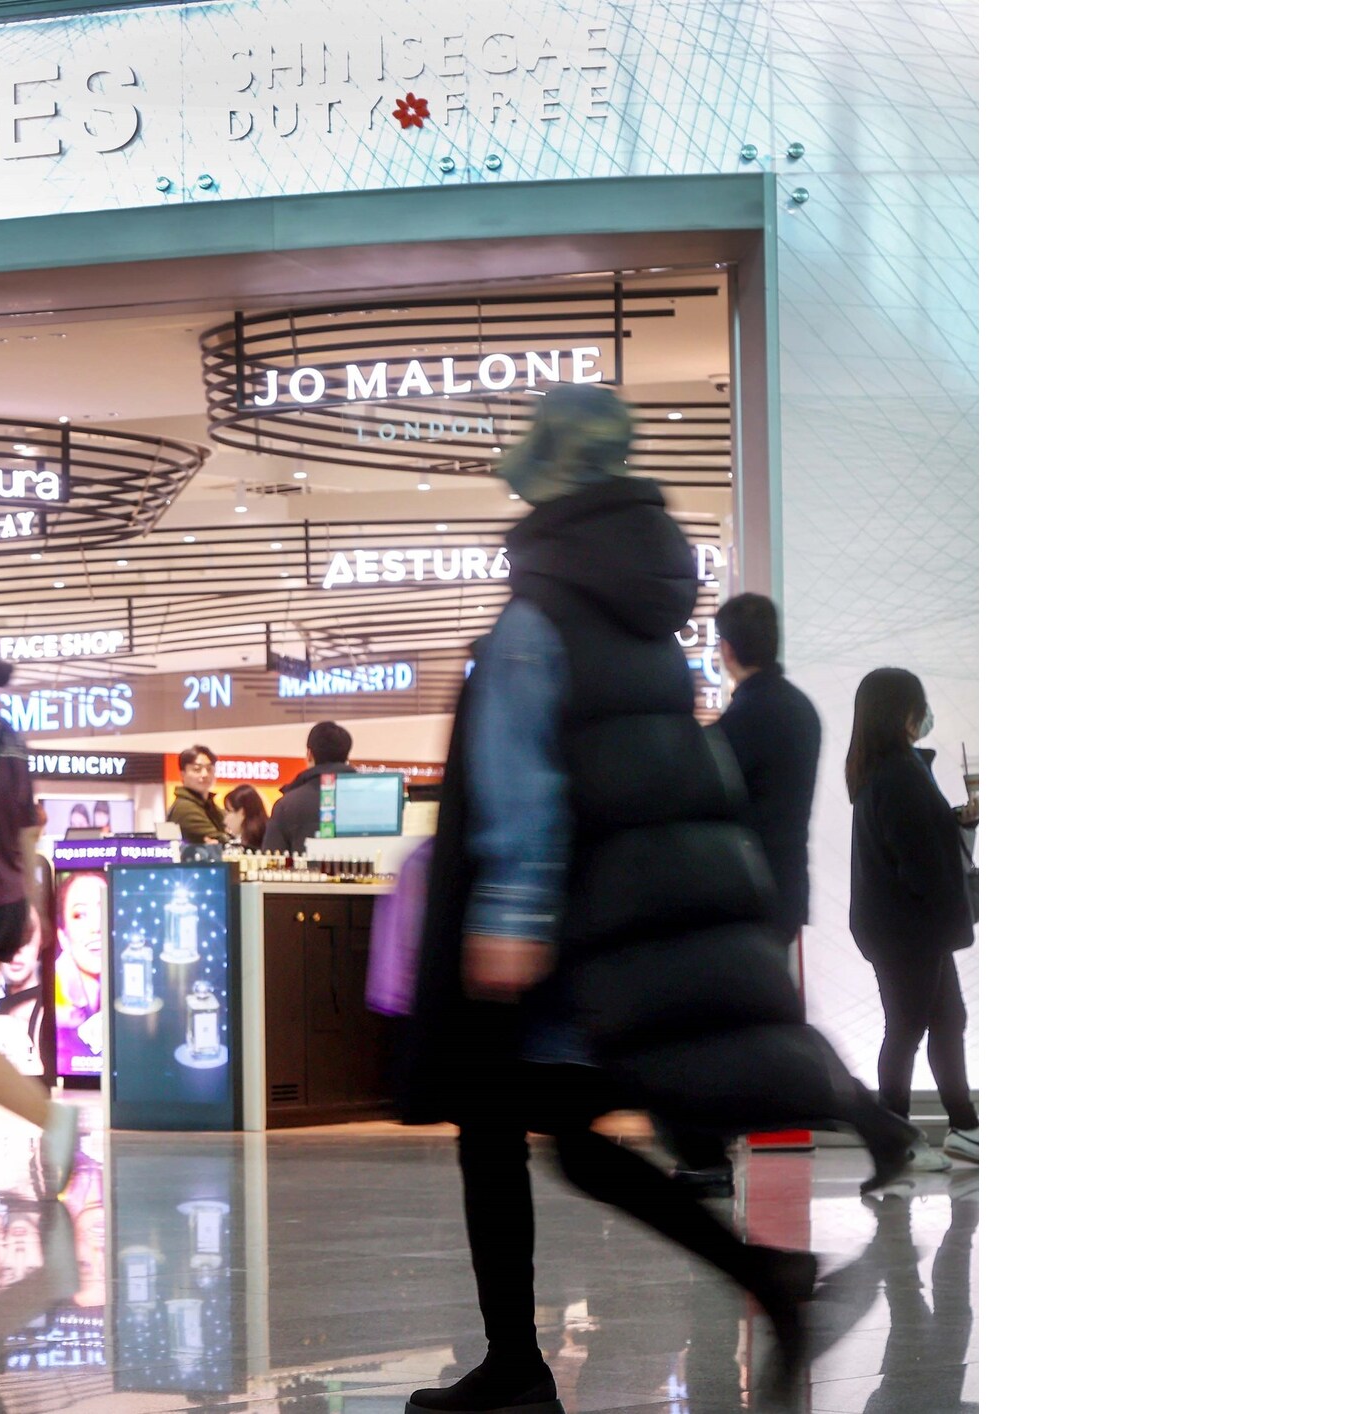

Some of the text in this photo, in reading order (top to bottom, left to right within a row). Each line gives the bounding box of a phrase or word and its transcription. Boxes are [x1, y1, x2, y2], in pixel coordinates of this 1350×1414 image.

[230, 27, 610, 94] SHINSEGAE
[227, 84, 610, 143] DUTY FREE
[254, 346, 603, 408] JO MALONE
[357, 416, 496, 443] LONDON
[322, 547, 511, 590] AESTURA
[0, 630, 124, 660] FACE SHOP
[27, 754, 127, 775] GIVENCHY
